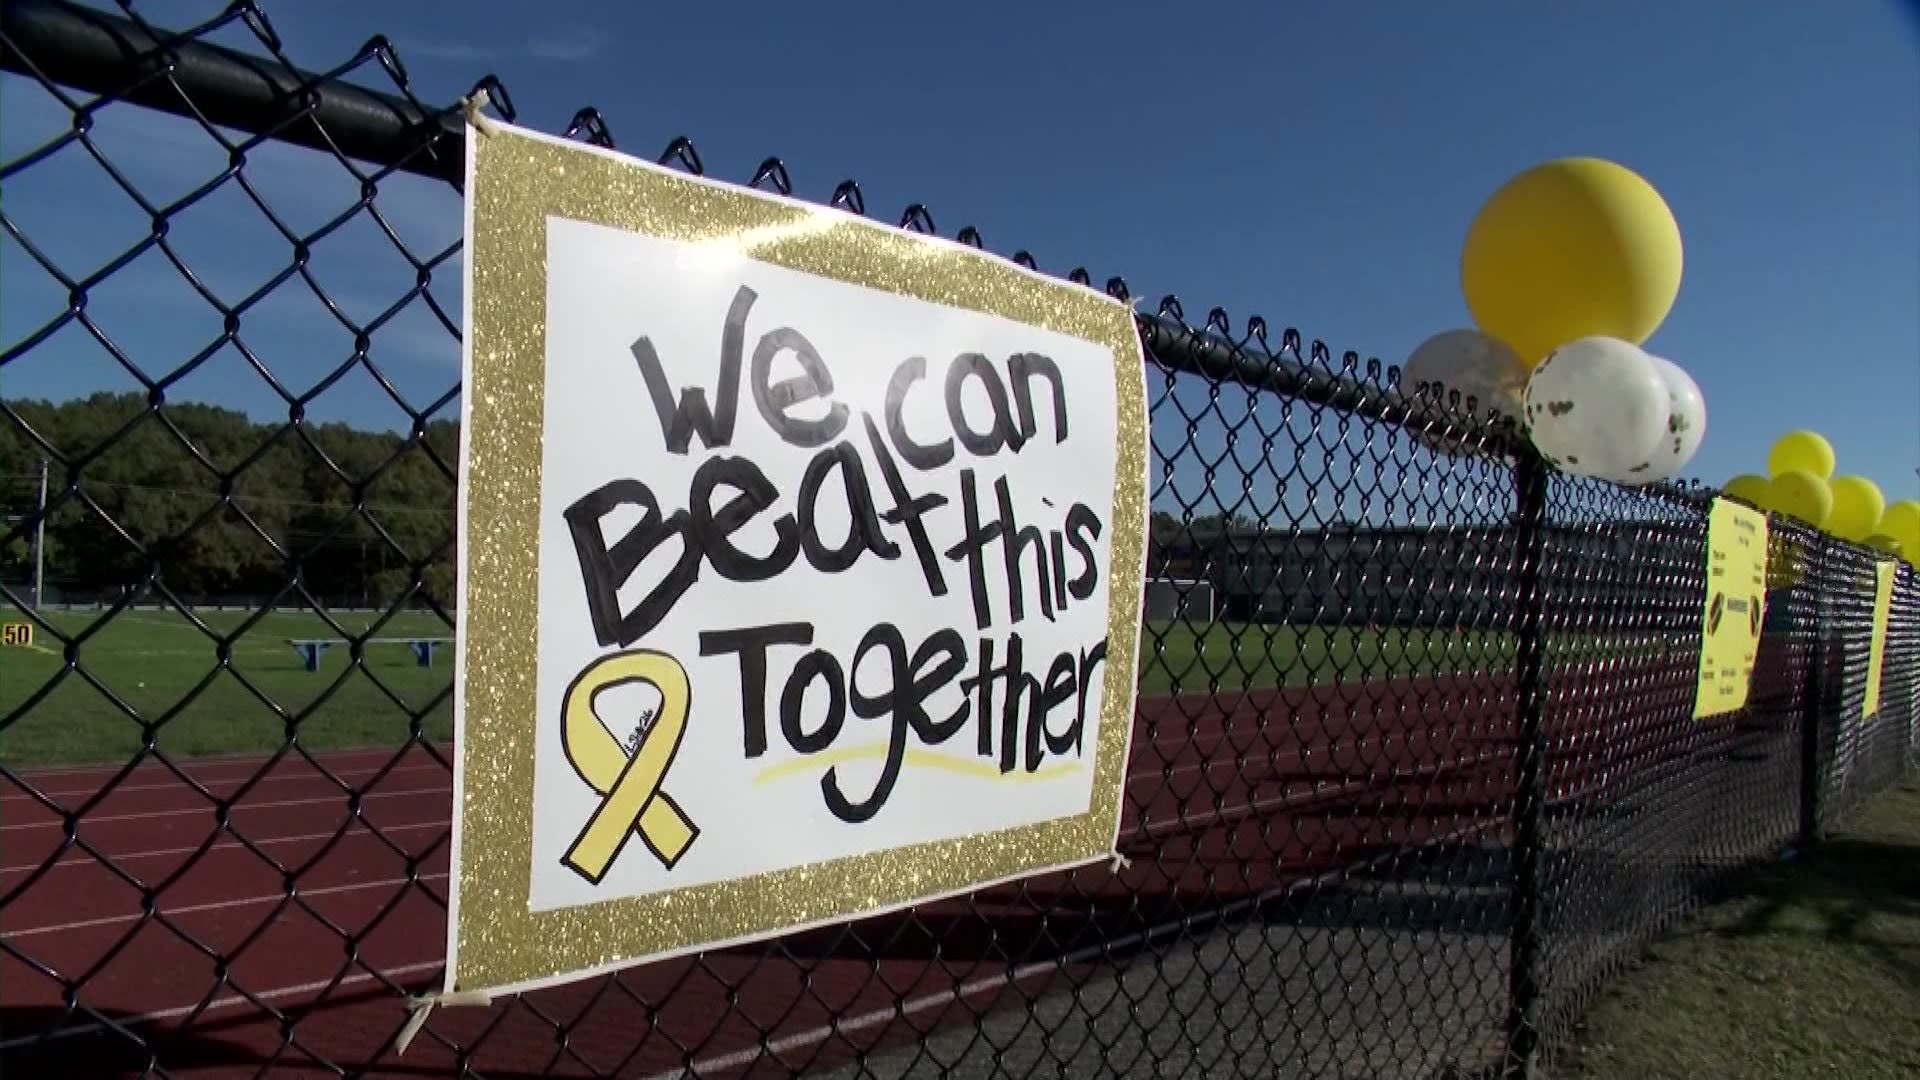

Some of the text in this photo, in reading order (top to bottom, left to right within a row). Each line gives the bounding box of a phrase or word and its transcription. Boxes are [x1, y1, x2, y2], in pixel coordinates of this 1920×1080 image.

[630, 284, 1068, 470] We can
[563, 410, 1102, 648] Beat this
[5, 624, 30, 645] 50
[699, 620, 1108, 823] Together
